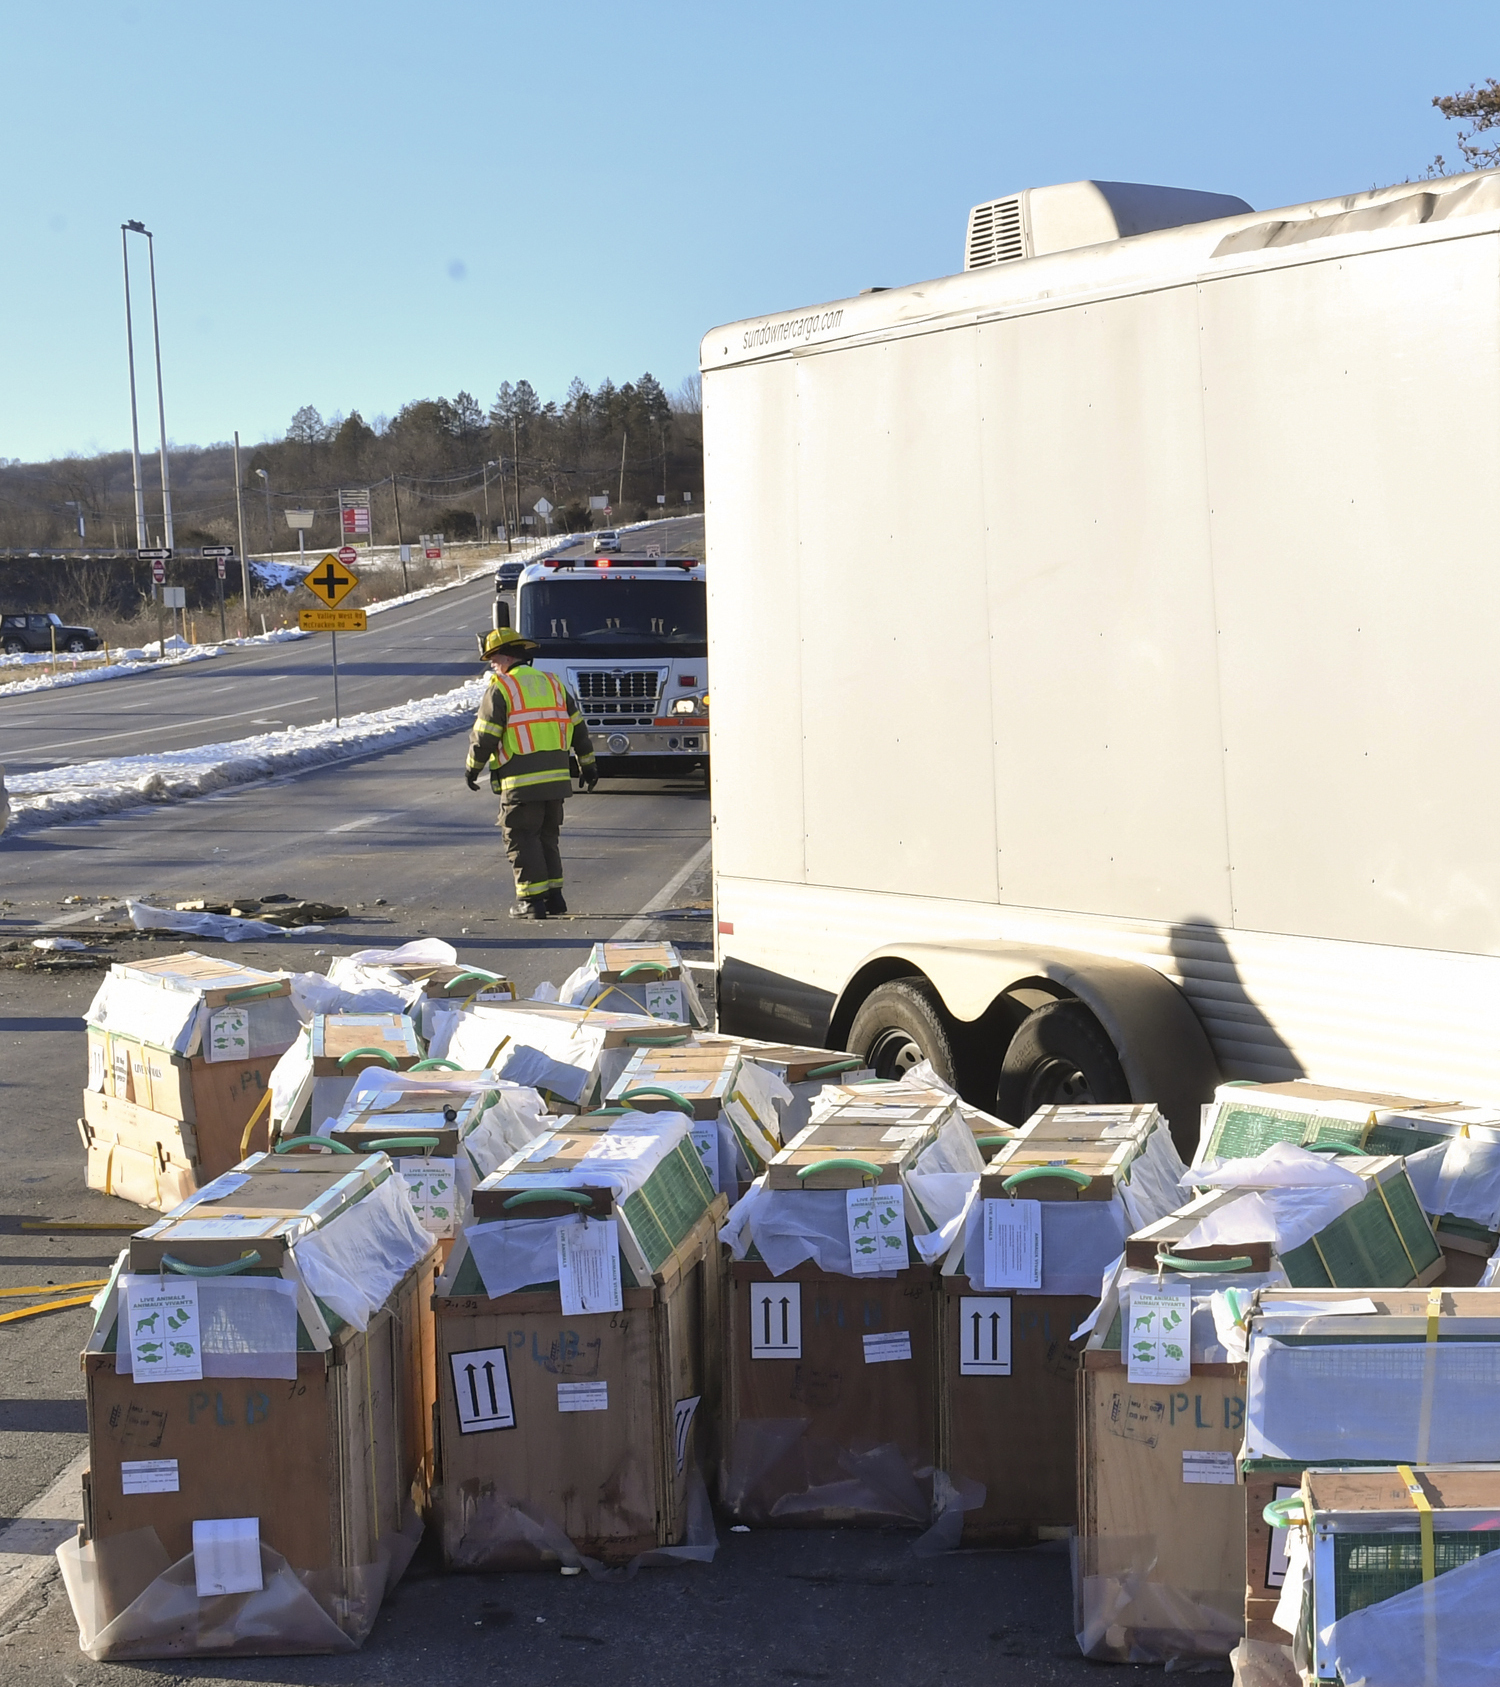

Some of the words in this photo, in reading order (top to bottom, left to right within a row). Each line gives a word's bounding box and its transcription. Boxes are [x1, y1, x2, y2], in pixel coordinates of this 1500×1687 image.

[743, 309, 844, 349] sundownercargo.com
[316, 612, 336, 620] Valley
[1169, 1392, 1246, 1430] PLB
